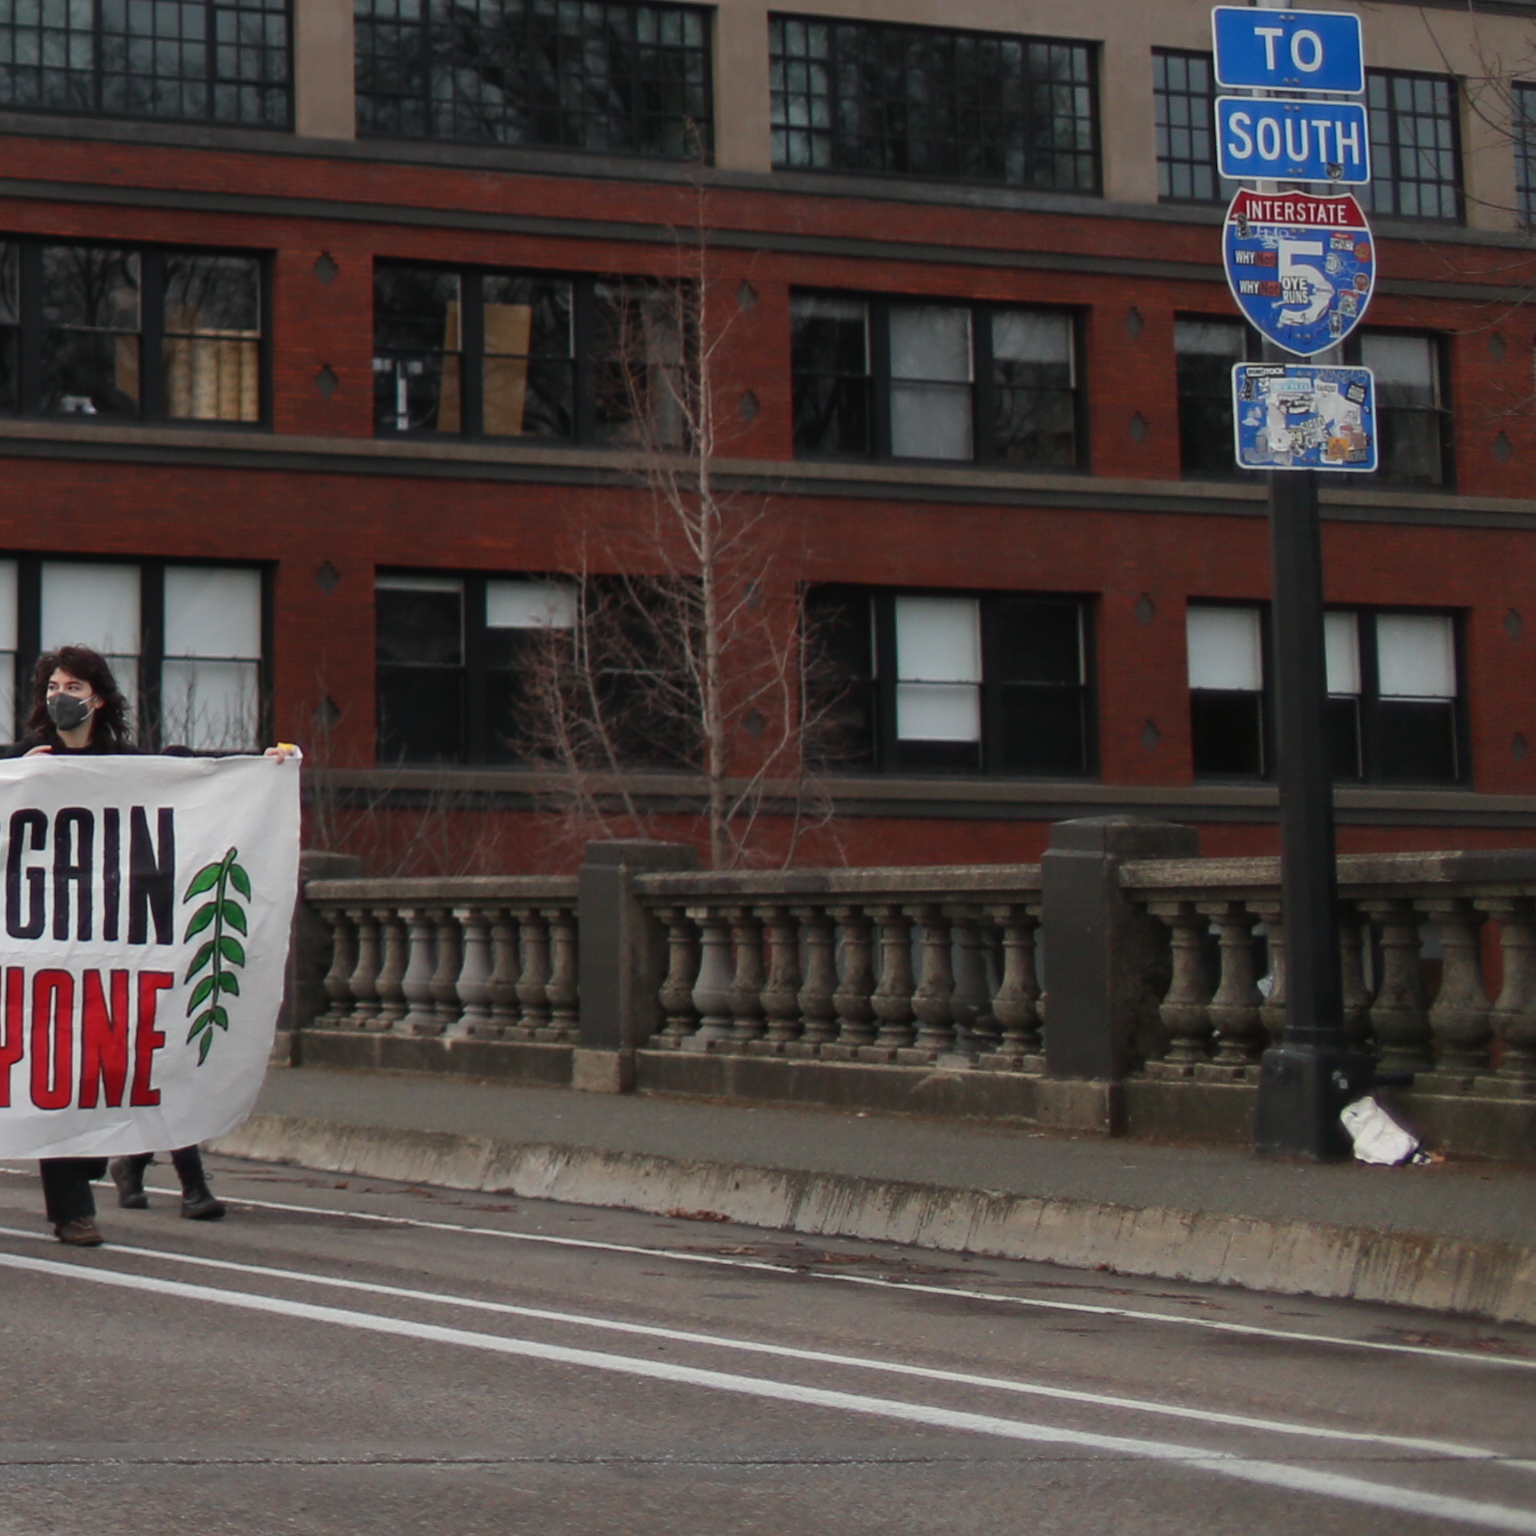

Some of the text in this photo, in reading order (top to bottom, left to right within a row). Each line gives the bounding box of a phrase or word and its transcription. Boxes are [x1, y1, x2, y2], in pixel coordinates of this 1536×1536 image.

[1254, 27, 1323, 73] TO
[1228, 112, 1360, 164] SOUTH
[1246, 199, 1348, 224] INTERSTATE
[1235, 250, 1256, 265] WHY
[1239, 280, 1260, 295] WHY
[1277, 239, 1335, 327] 5
[1281, 277, 1308, 291] OYE
[1282, 290, 1309, 305] RUNS
